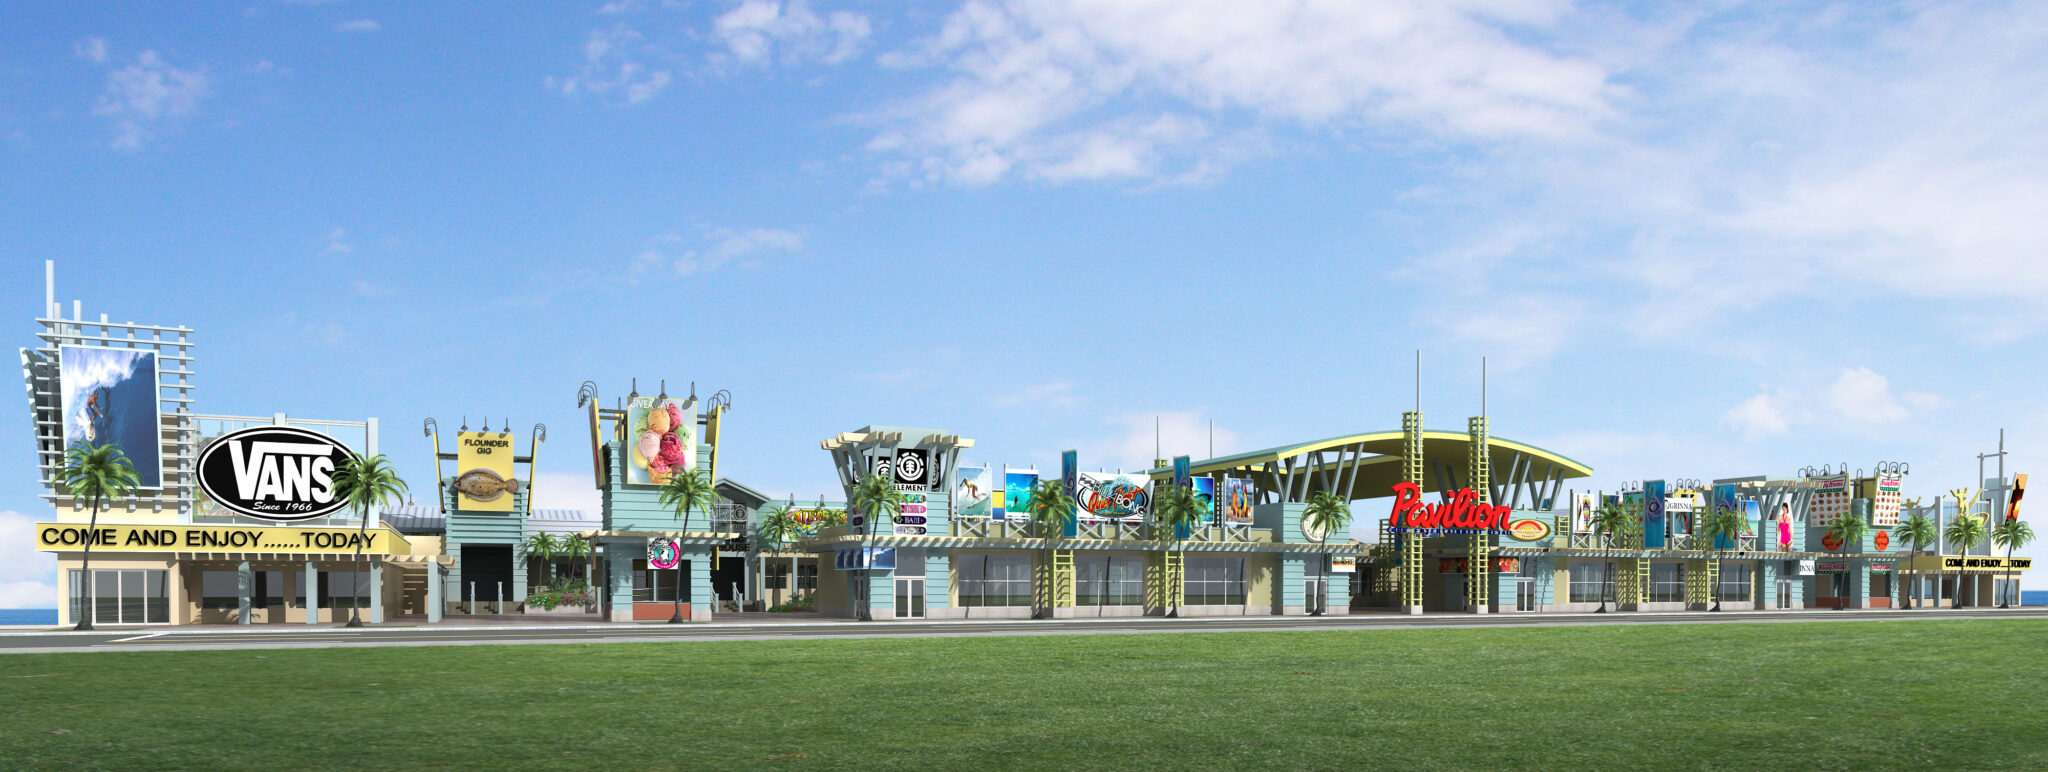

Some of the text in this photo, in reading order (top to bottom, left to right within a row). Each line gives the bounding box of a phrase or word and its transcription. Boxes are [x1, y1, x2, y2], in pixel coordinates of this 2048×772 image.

[465, 439, 509, 448] FLOUNDER
[477, 447, 492, 455] GIG
[228, 439, 335, 504] VANS
[253, 502, 313, 511] Since 1966
[1388, 482, 1512, 530] Pavilion
[41, 527, 118, 547] COME
[125, 527, 177, 548] AND
